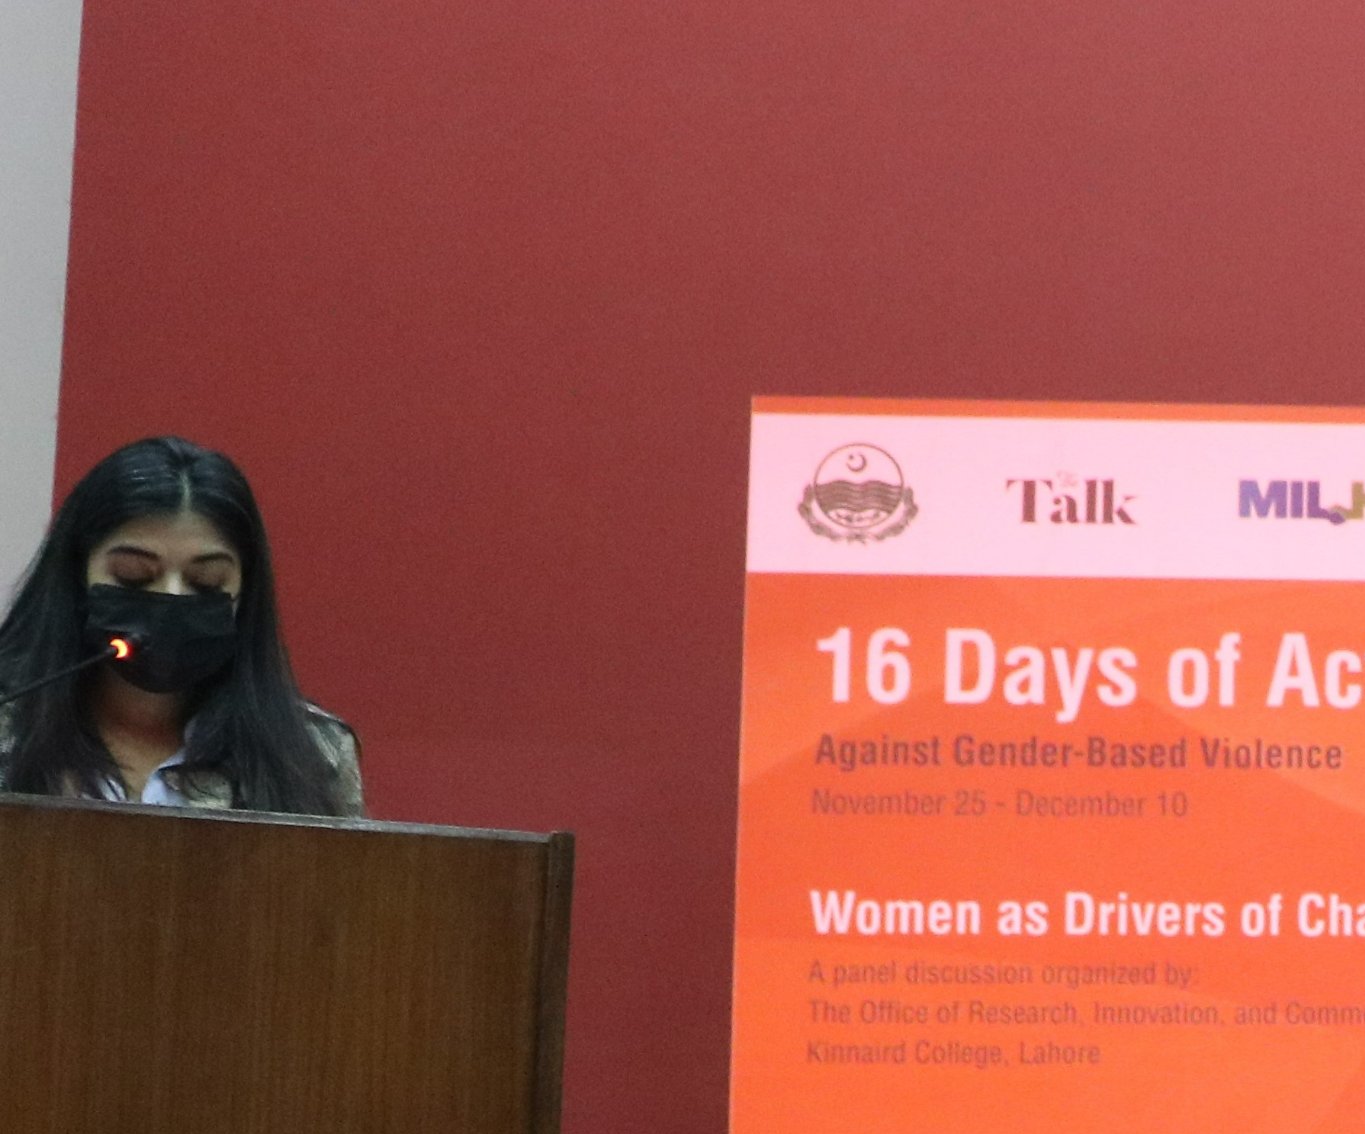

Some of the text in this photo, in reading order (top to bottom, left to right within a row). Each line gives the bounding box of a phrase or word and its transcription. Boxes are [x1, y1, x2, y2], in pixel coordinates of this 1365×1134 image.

[1006, 478, 1137, 525] Talk
[816, 626, 912, 705] 16
[944, 626, 1138, 724] Days
[1166, 631, 1242, 711] of
[815, 733, 1343, 772] Against Gender-Based Violence
[810, 788, 948, 817] November
[954, 789, 987, 816] 25
[1014, 790, 1147, 818] December
[1156, 792, 1189, 817] 10
[810, 889, 982, 936] Women
[996, 901, 1049, 936] as
[1062, 891, 1225, 938] Drivers
[1239, 892, 1284, 938] of
[807, 960, 826, 983] A
[833, 960, 897, 988] panel
[905, 961, 1032, 985] discussion
[1041, 962, 1157, 990] organized
[808, 1001, 852, 1024] The
[858, 1001, 929, 1024] Office
[935, 1001, 960, 1024] of
[1234, 1002, 1277, 1026] and
[805, 1040, 1100, 1070] Kinnaird College, Lahore
